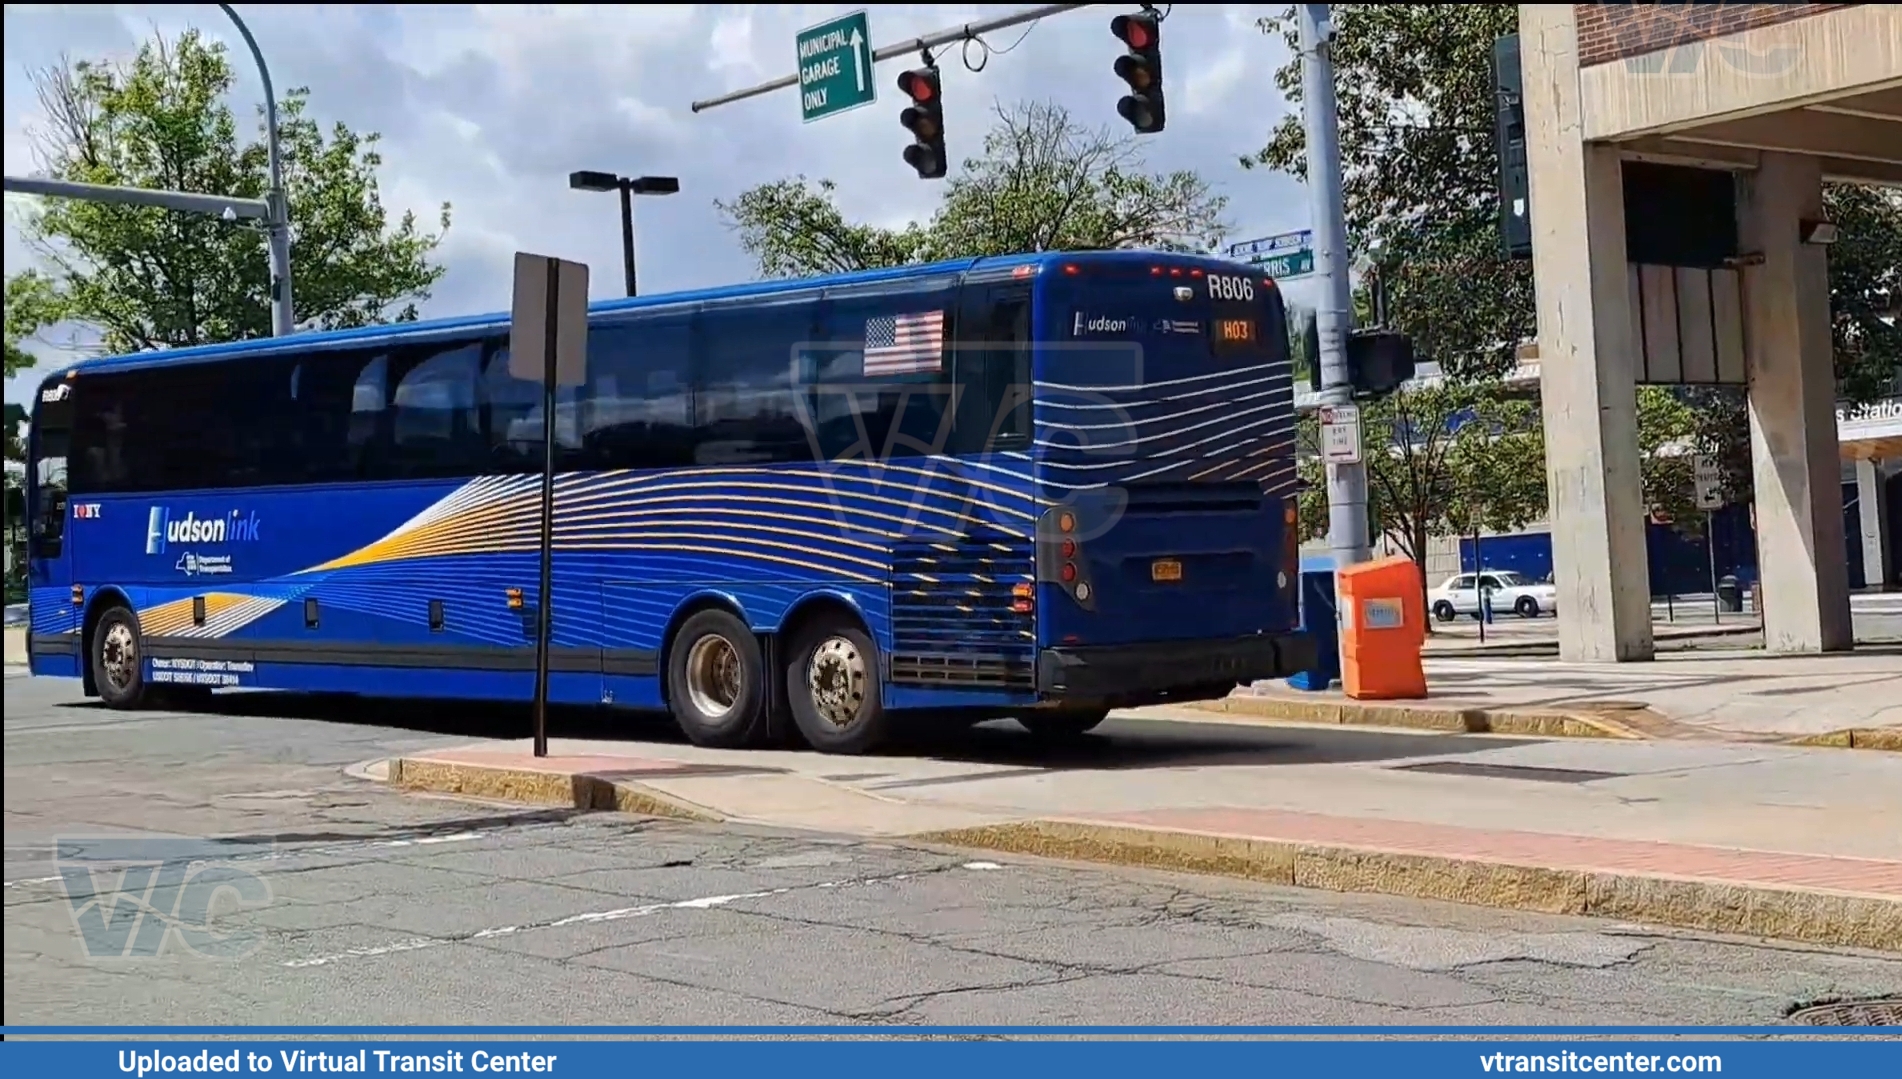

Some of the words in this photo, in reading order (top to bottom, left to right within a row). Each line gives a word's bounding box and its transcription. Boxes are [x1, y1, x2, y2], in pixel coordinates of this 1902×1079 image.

[799, 28, 849, 60] MUNICIPAL
[802, 56, 841, 86] GARAGE
[804, 86, 828, 111] ONLY
[1207, 274, 1254, 300] R806
[1224, 320, 1248, 339] H03
